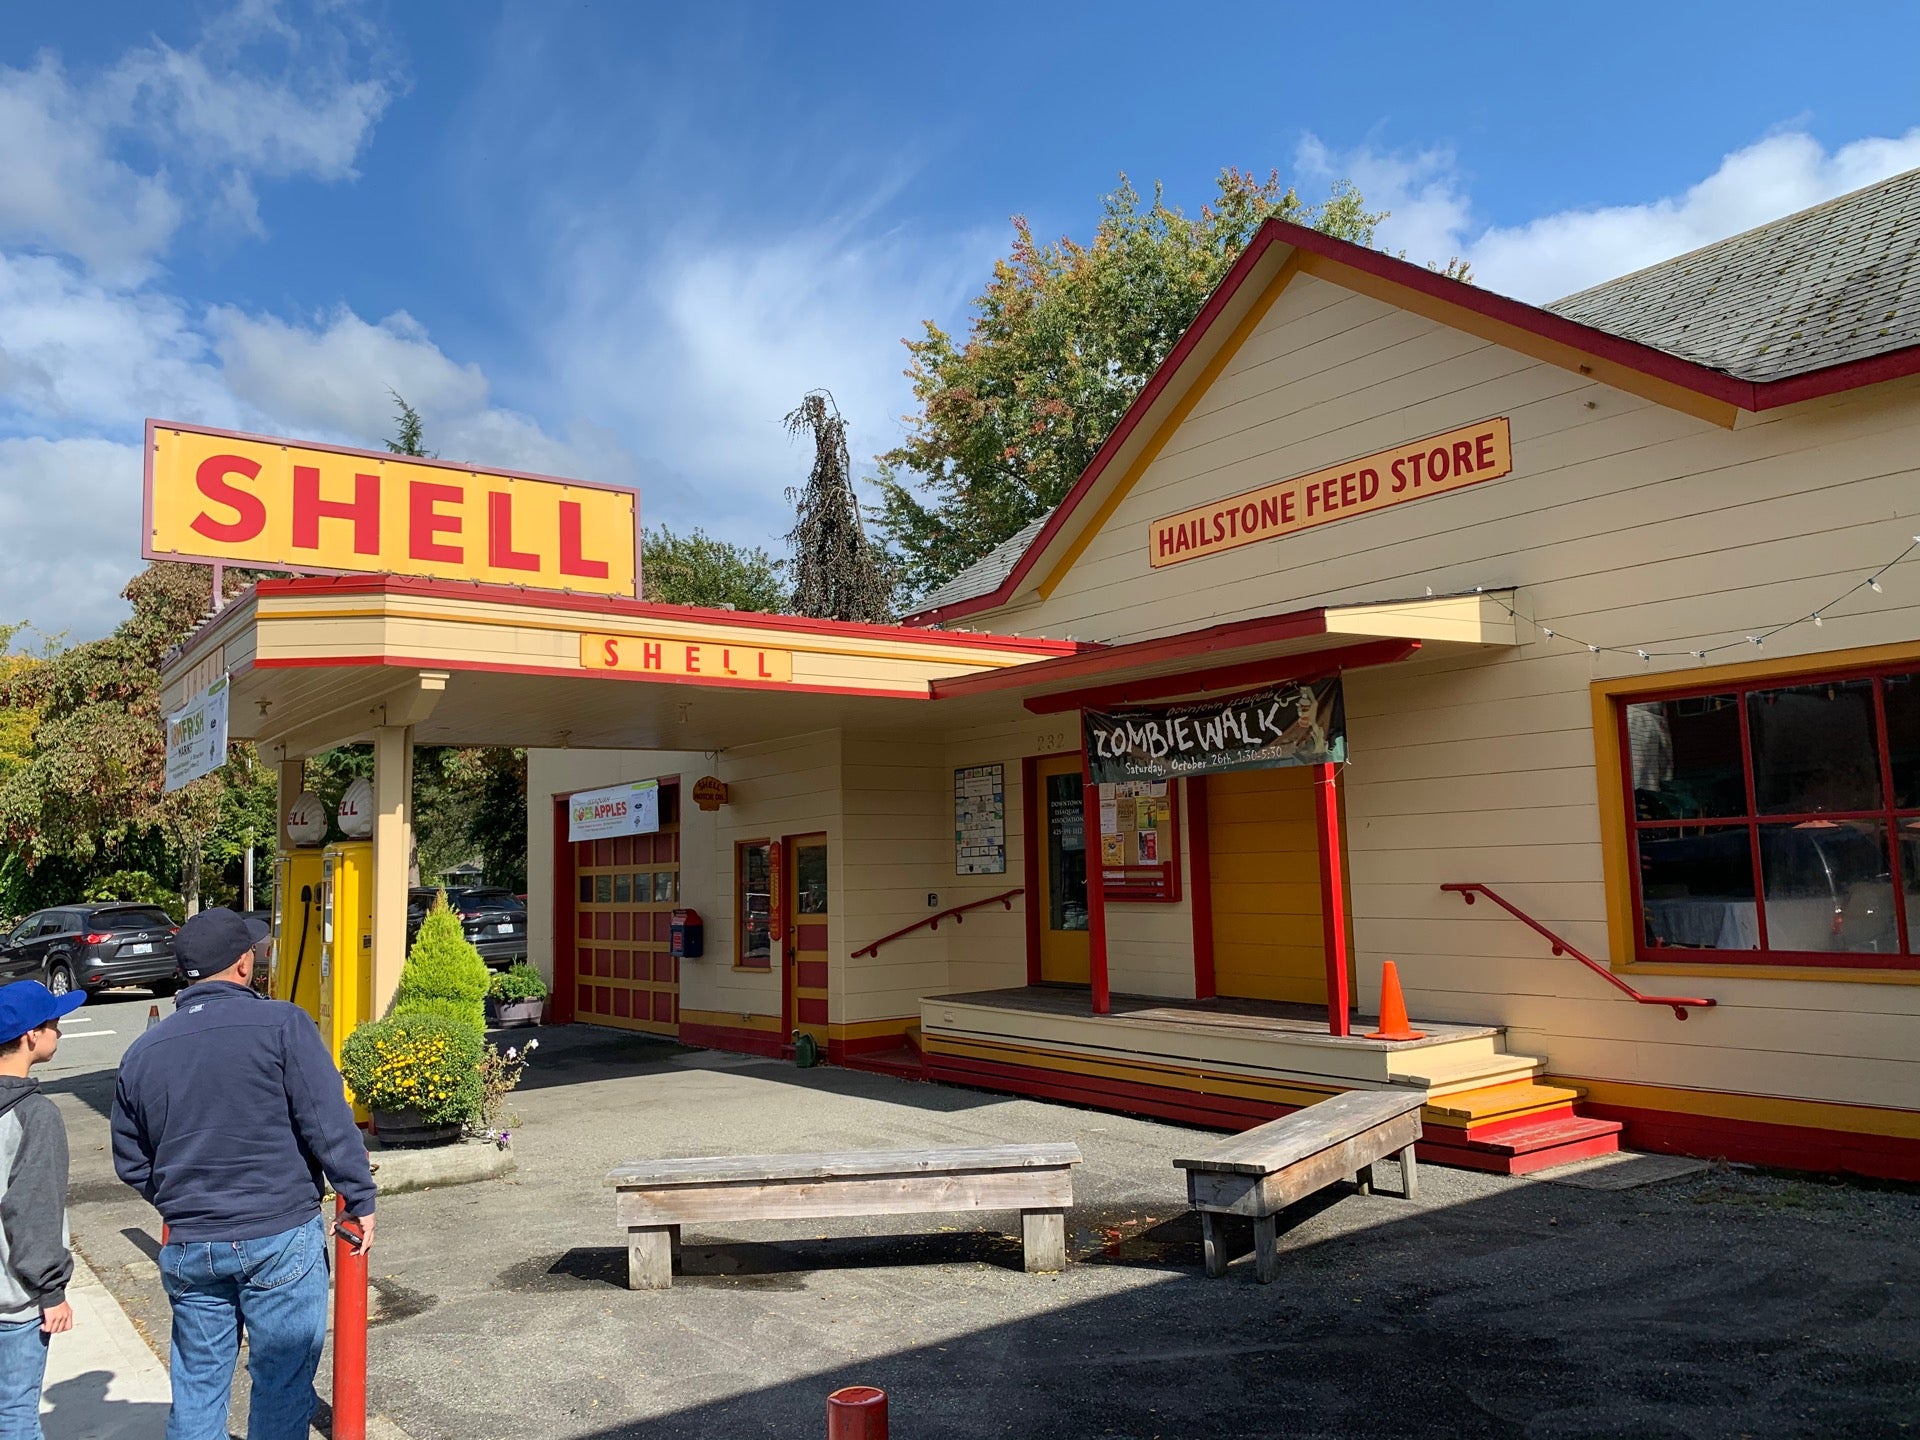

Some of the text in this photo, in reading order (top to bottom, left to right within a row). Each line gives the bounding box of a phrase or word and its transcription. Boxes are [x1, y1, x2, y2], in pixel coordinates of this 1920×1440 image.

[1158, 432, 1496, 558] HAILSTONE FEED STORE
[189, 453, 609, 580] SHELL
[604, 638, 772, 678] SHELL
[1037, 733, 1064, 752] 232
[1125, 760, 1166, 776] Saturday,
[1171, 757, 1207, 771] October
[1237, 746, 1282, 763] 1:30-5:30
[594, 801, 627, 820] APPLES
[1051, 800, 1083, 808] DOWNTOWN
